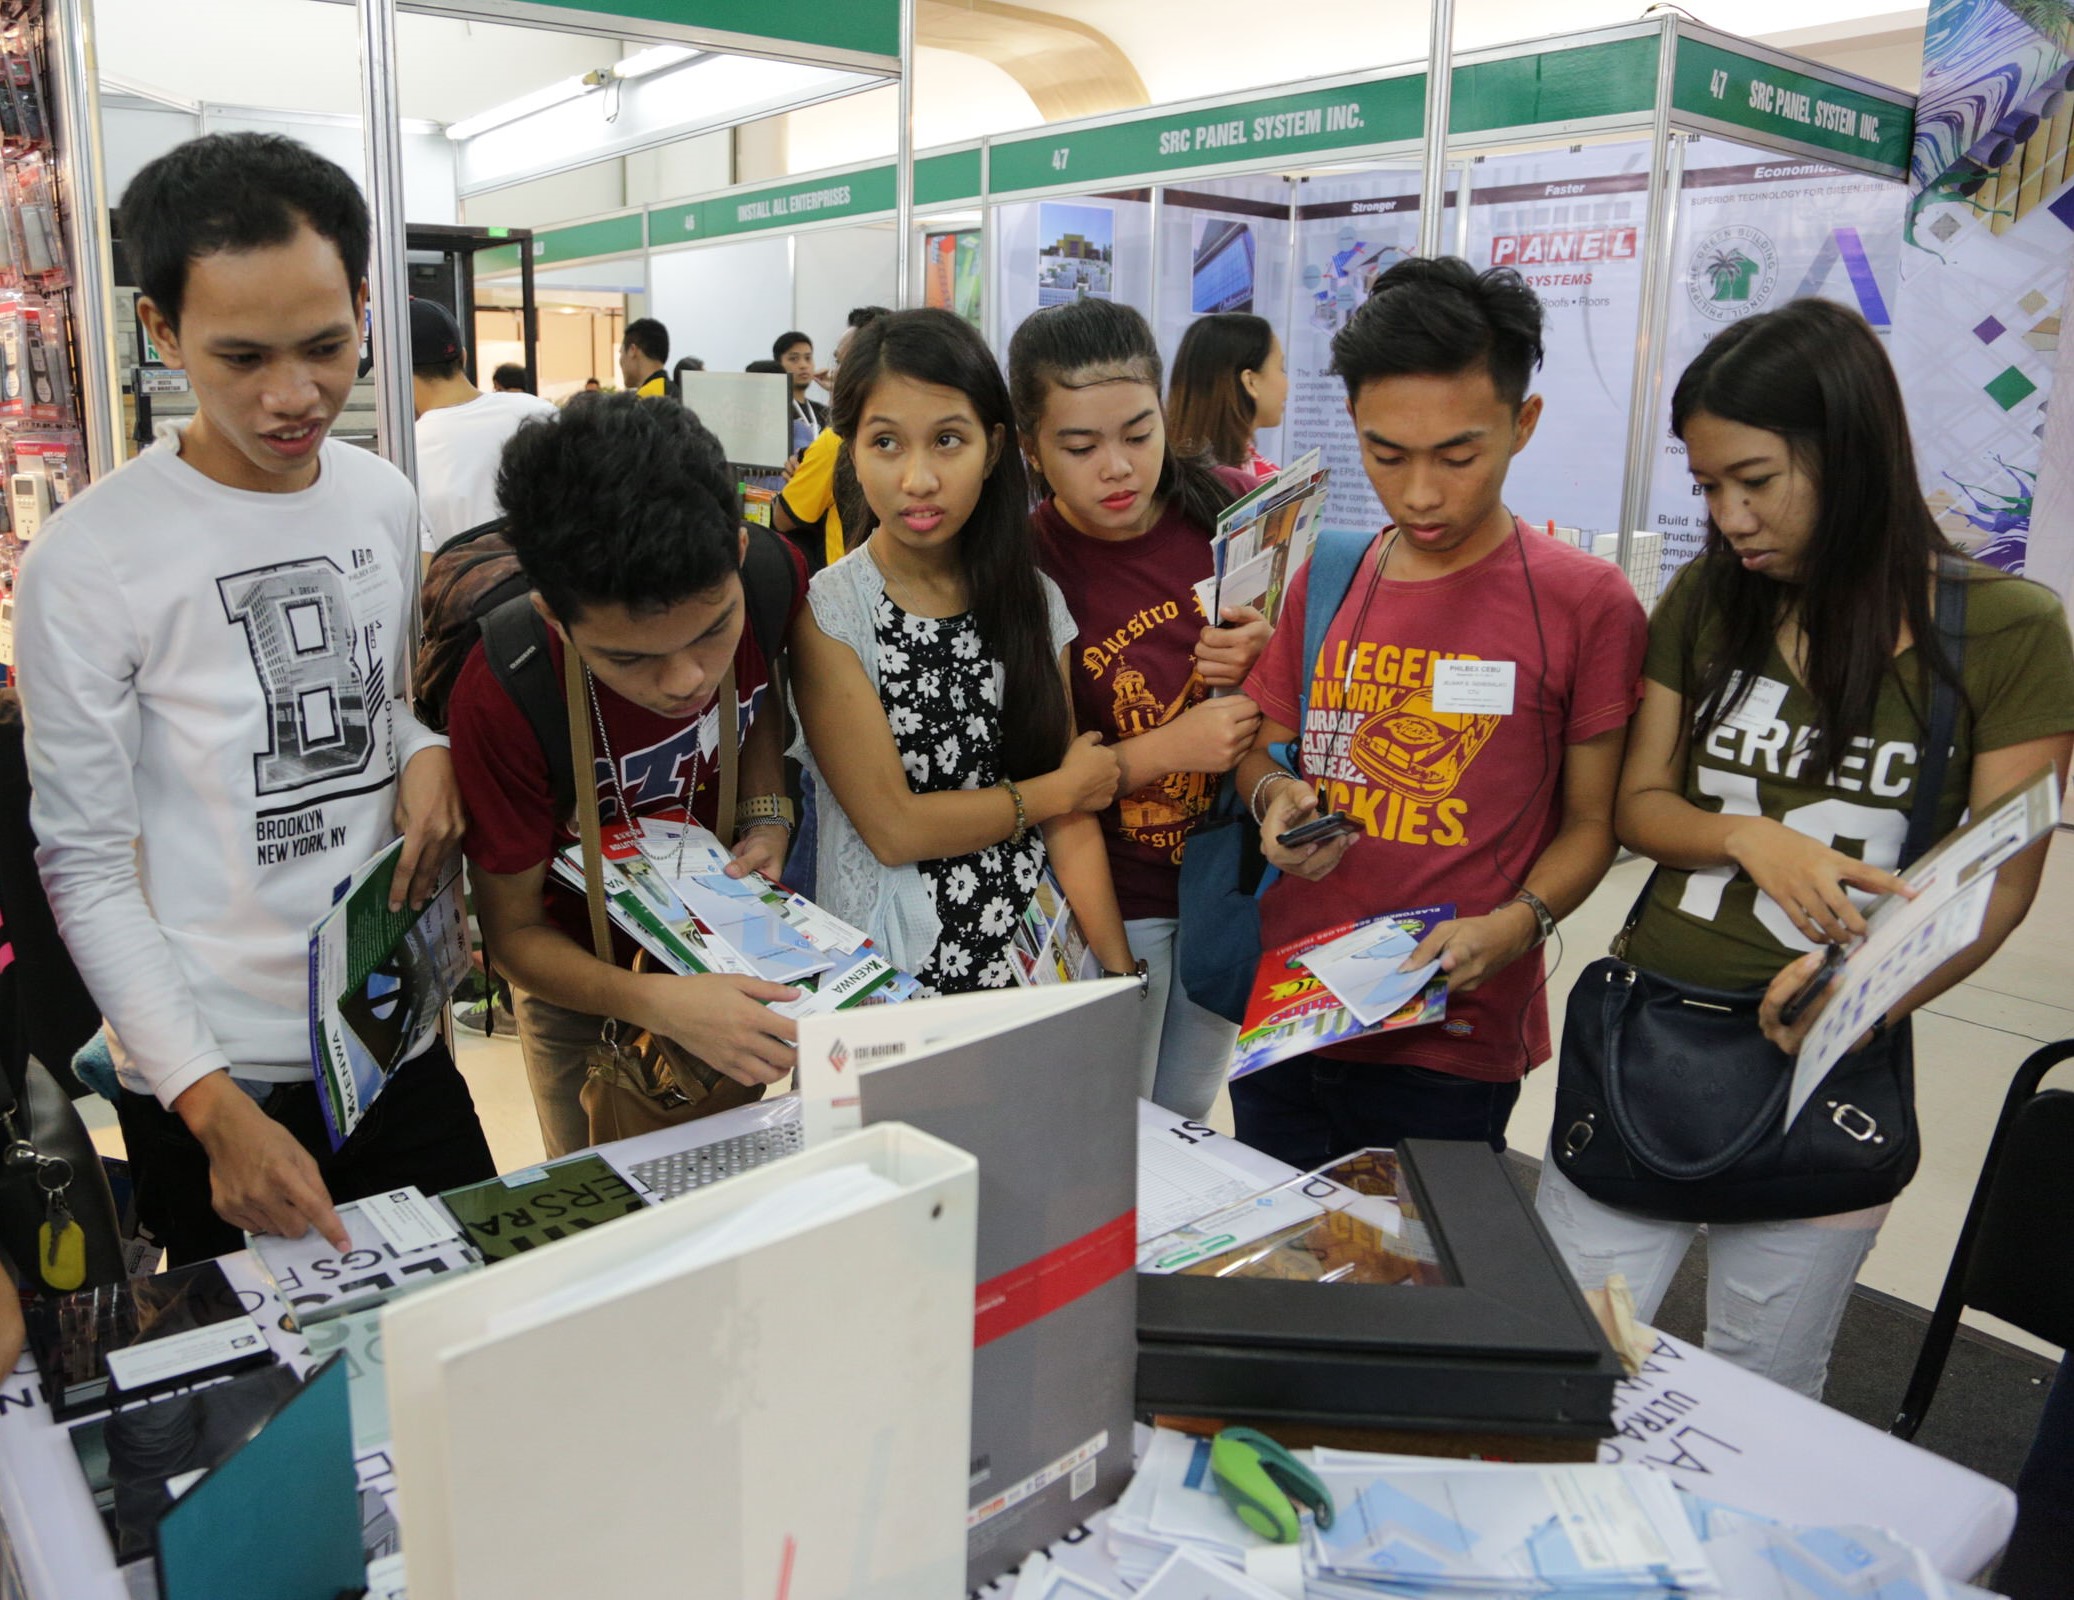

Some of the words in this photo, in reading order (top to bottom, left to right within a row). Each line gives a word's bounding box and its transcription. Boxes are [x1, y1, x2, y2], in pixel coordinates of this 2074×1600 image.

[1710, 69, 1728, 99] 47
[1749, 80, 1773, 113] SRC
[1775, 87, 1811, 124] PANEL
[1814, 100, 1855, 137] SYSTEM
[1859, 113, 1881, 143] INC.
[1051, 148, 1070, 171] 47
[1159, 129, 1191, 155] SRC
[1195, 121, 1247, 151] PANEL
[1253, 109, 1321, 142] SYSTEM
[1326, 103, 1365, 132] INC.
[1545, 182, 1585, 196] Faster
[1738, 189, 1801, 202] TECHNOLOGY
[1804, 186, 1825, 198] FOR
[737, 200, 771, 222] INSTALL
[773, 197, 790, 216] ALL
[790, 186, 850, 212] ENTERPRISES
[1351, 200, 1397, 214] Stronger
[1493, 229, 1635, 265] PANEL
[1526, 272, 1593, 288] SYSTEMS
[1541, 297, 1569, 308] Roofs
[1579, 295, 1611, 307] Floors
[1658, 514, 1689, 527] Build
[1083, 600, 1180, 681] Nuestro
[1302, 732, 1353, 757] CLOTHE
[256, 809, 324, 842] BROOKLYN
[257, 841, 288, 866] NEW
[292, 833, 327, 858] YORK,
[331, 826, 346, 848] NY
